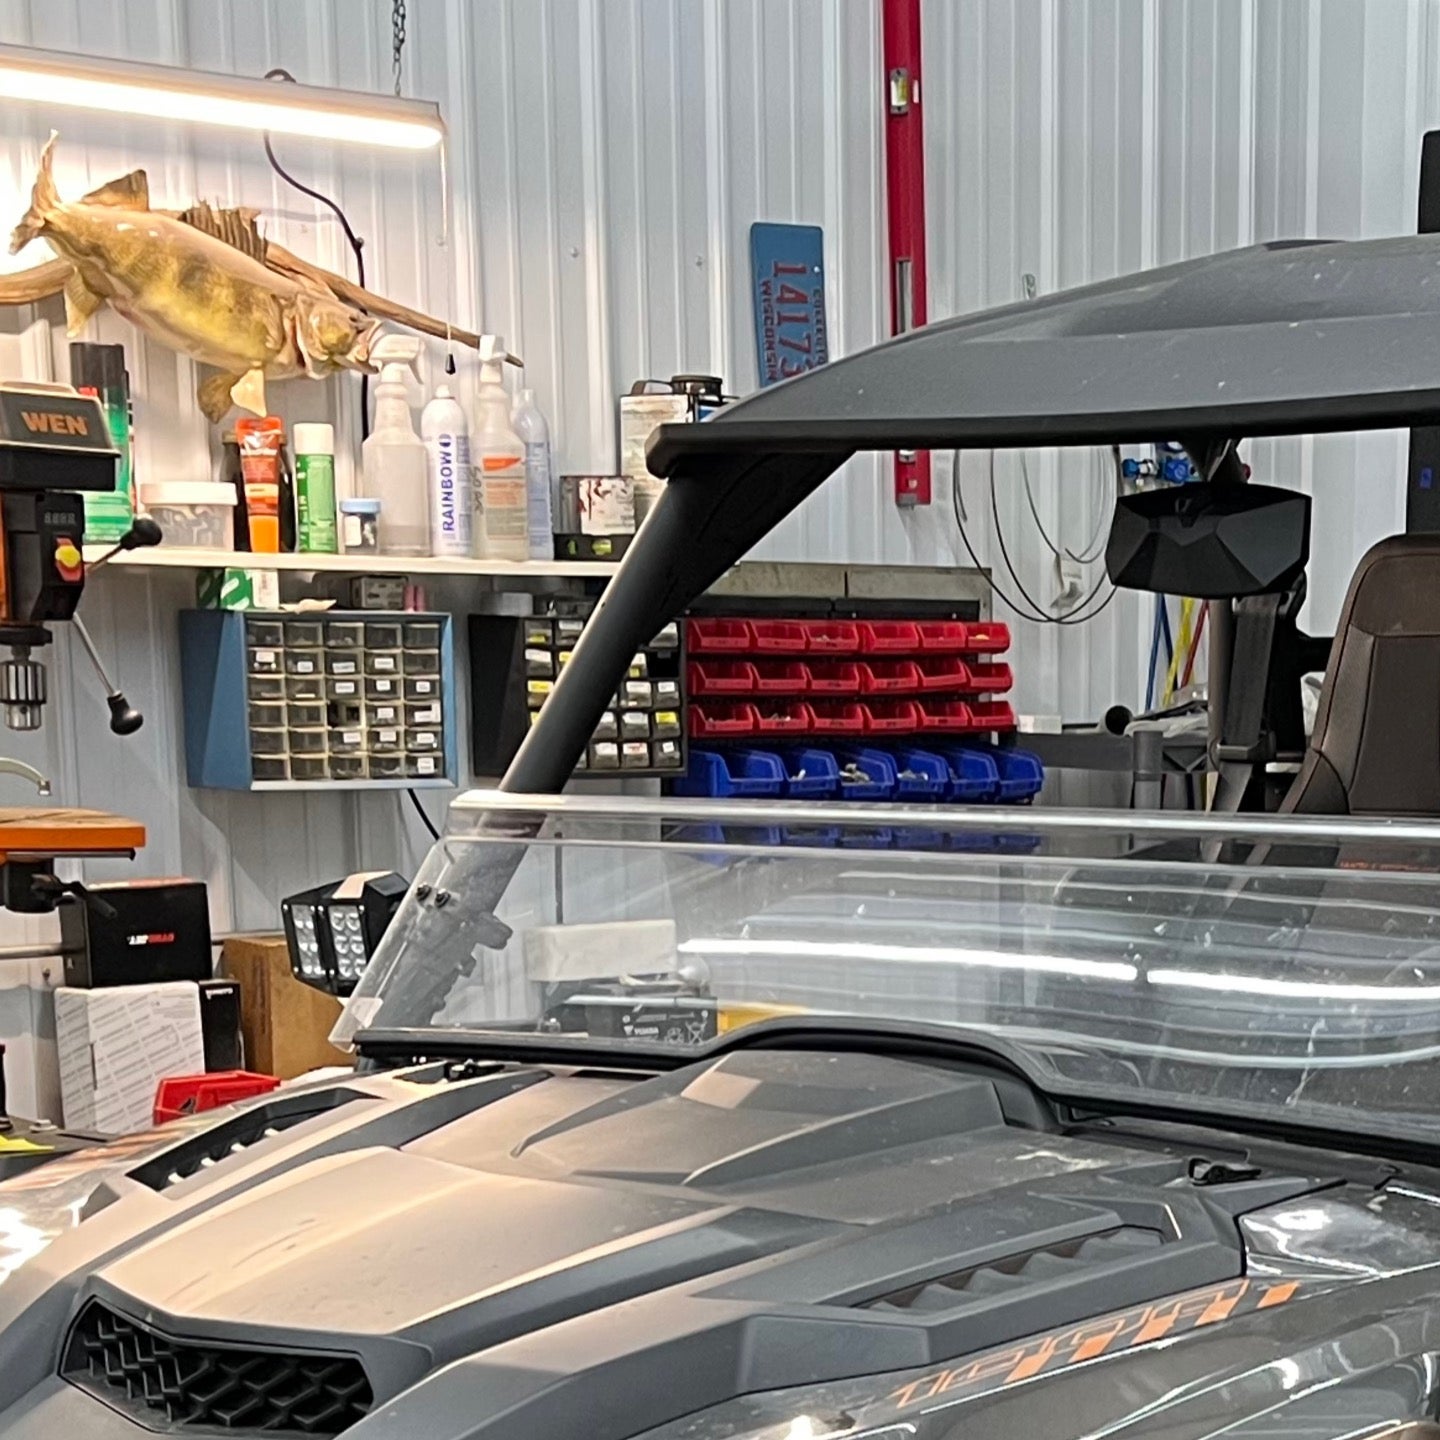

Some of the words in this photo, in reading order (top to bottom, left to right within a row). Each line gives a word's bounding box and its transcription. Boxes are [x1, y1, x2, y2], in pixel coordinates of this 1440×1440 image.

[760, 279, 777, 381] WISCONSIN
[21, 411, 88, 436] WEN
[440, 451, 454, 531] RAINBOW
